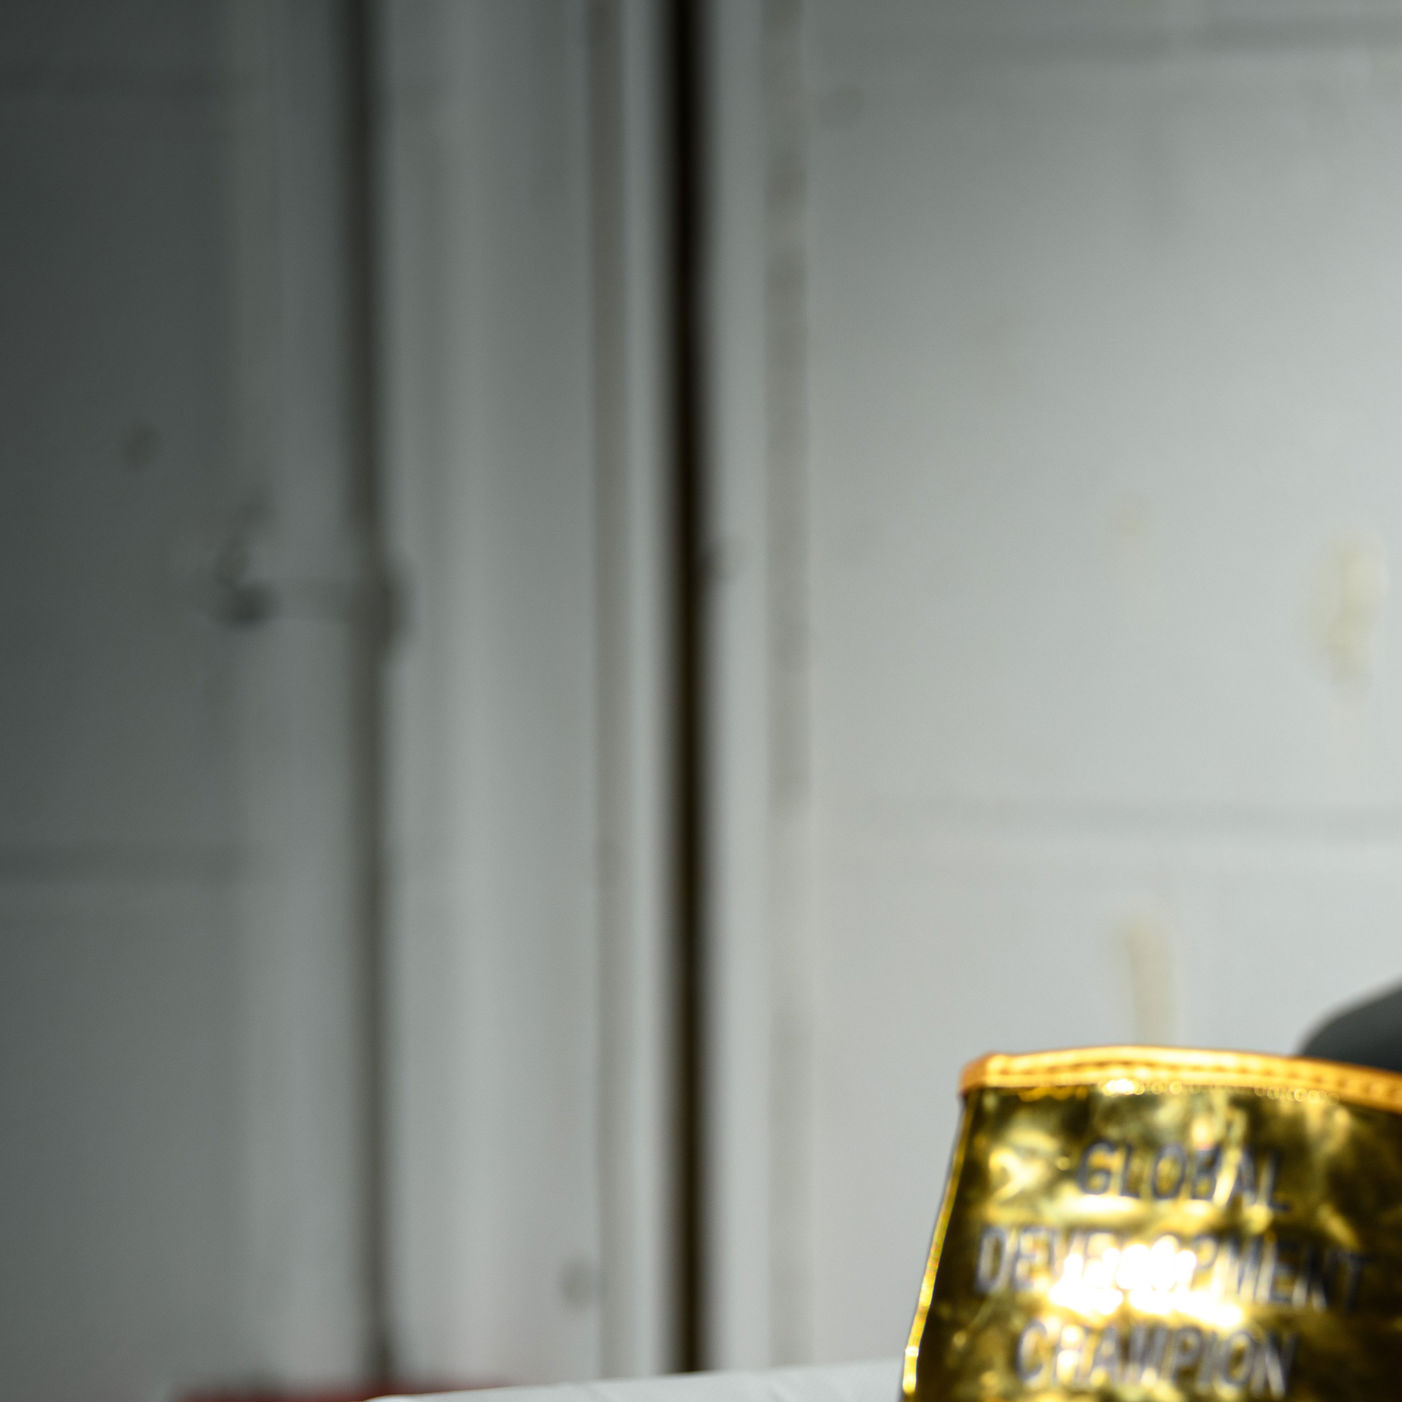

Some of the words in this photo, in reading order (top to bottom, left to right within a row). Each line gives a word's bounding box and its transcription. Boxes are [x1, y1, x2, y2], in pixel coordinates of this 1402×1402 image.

[1075, 1138, 1290, 1212] GLOBAL
[975, 1225, 1370, 1310] DEVEPMENT
[1015, 1321, 1298, 1397] CHAMPION
